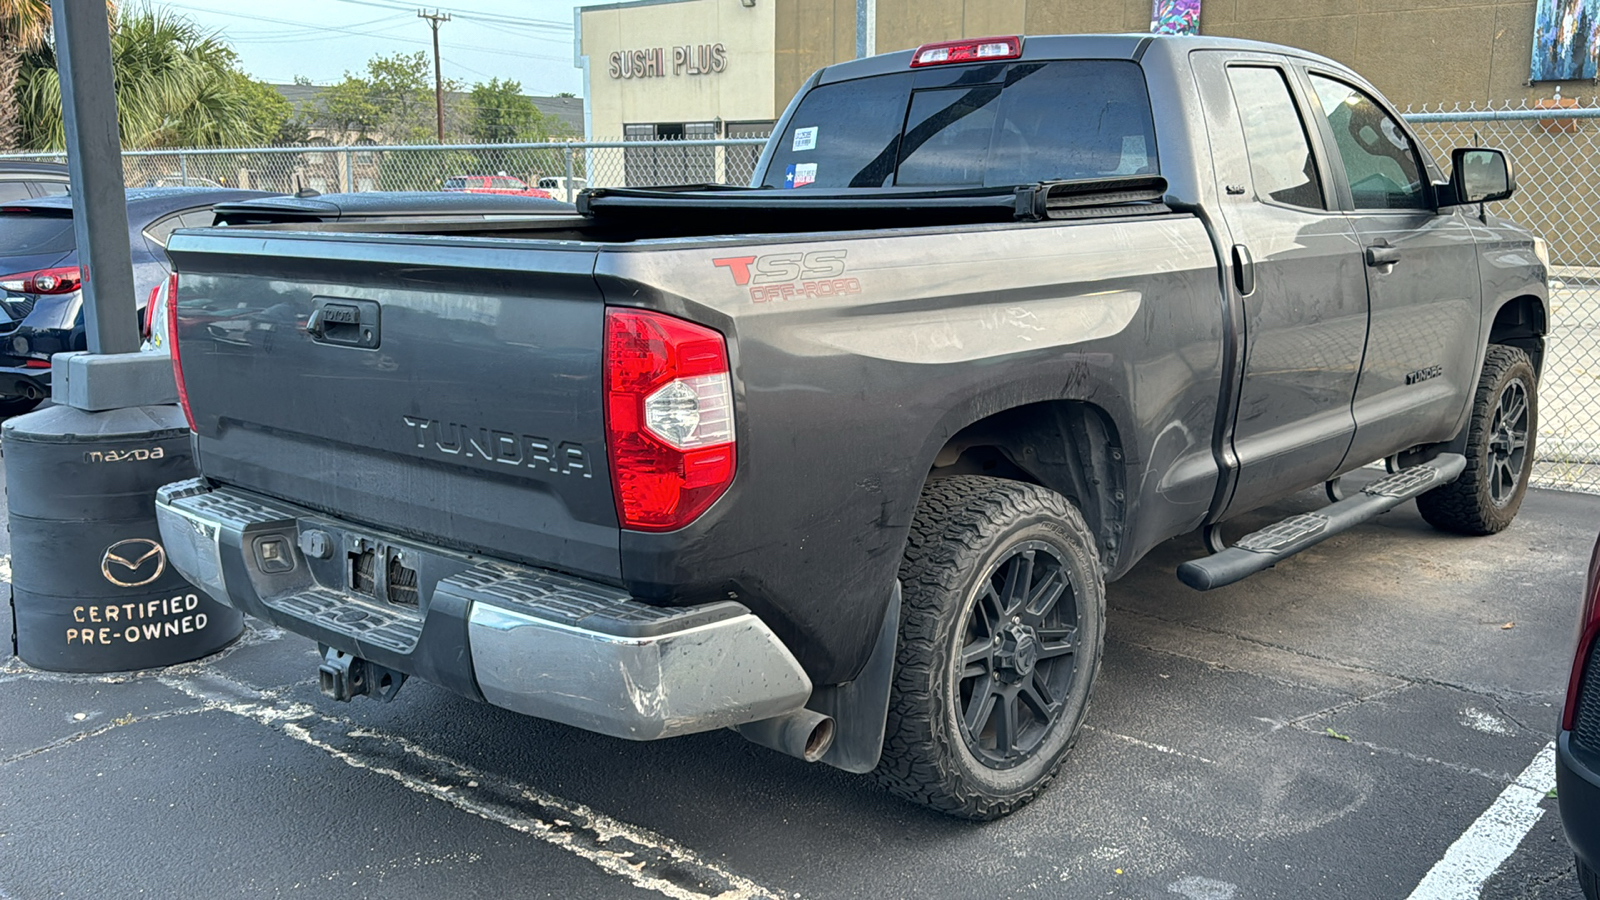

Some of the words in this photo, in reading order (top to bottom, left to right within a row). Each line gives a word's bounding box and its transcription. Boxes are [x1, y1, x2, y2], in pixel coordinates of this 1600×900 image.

[609, 48, 665, 79] SUSHI
[672, 43, 727, 76] PLUS
[712, 249, 848, 286] TSS
[749, 277, 862, 304] OFF-ROAD
[323, 309, 353, 322] TOYOTA
[1406, 364, 1443, 385] TUNDRA
[403, 415, 592, 478] TUNDRA
[73, 593, 199, 623] CERTIFIED
[66, 613, 208, 645] PRE-OWNED
